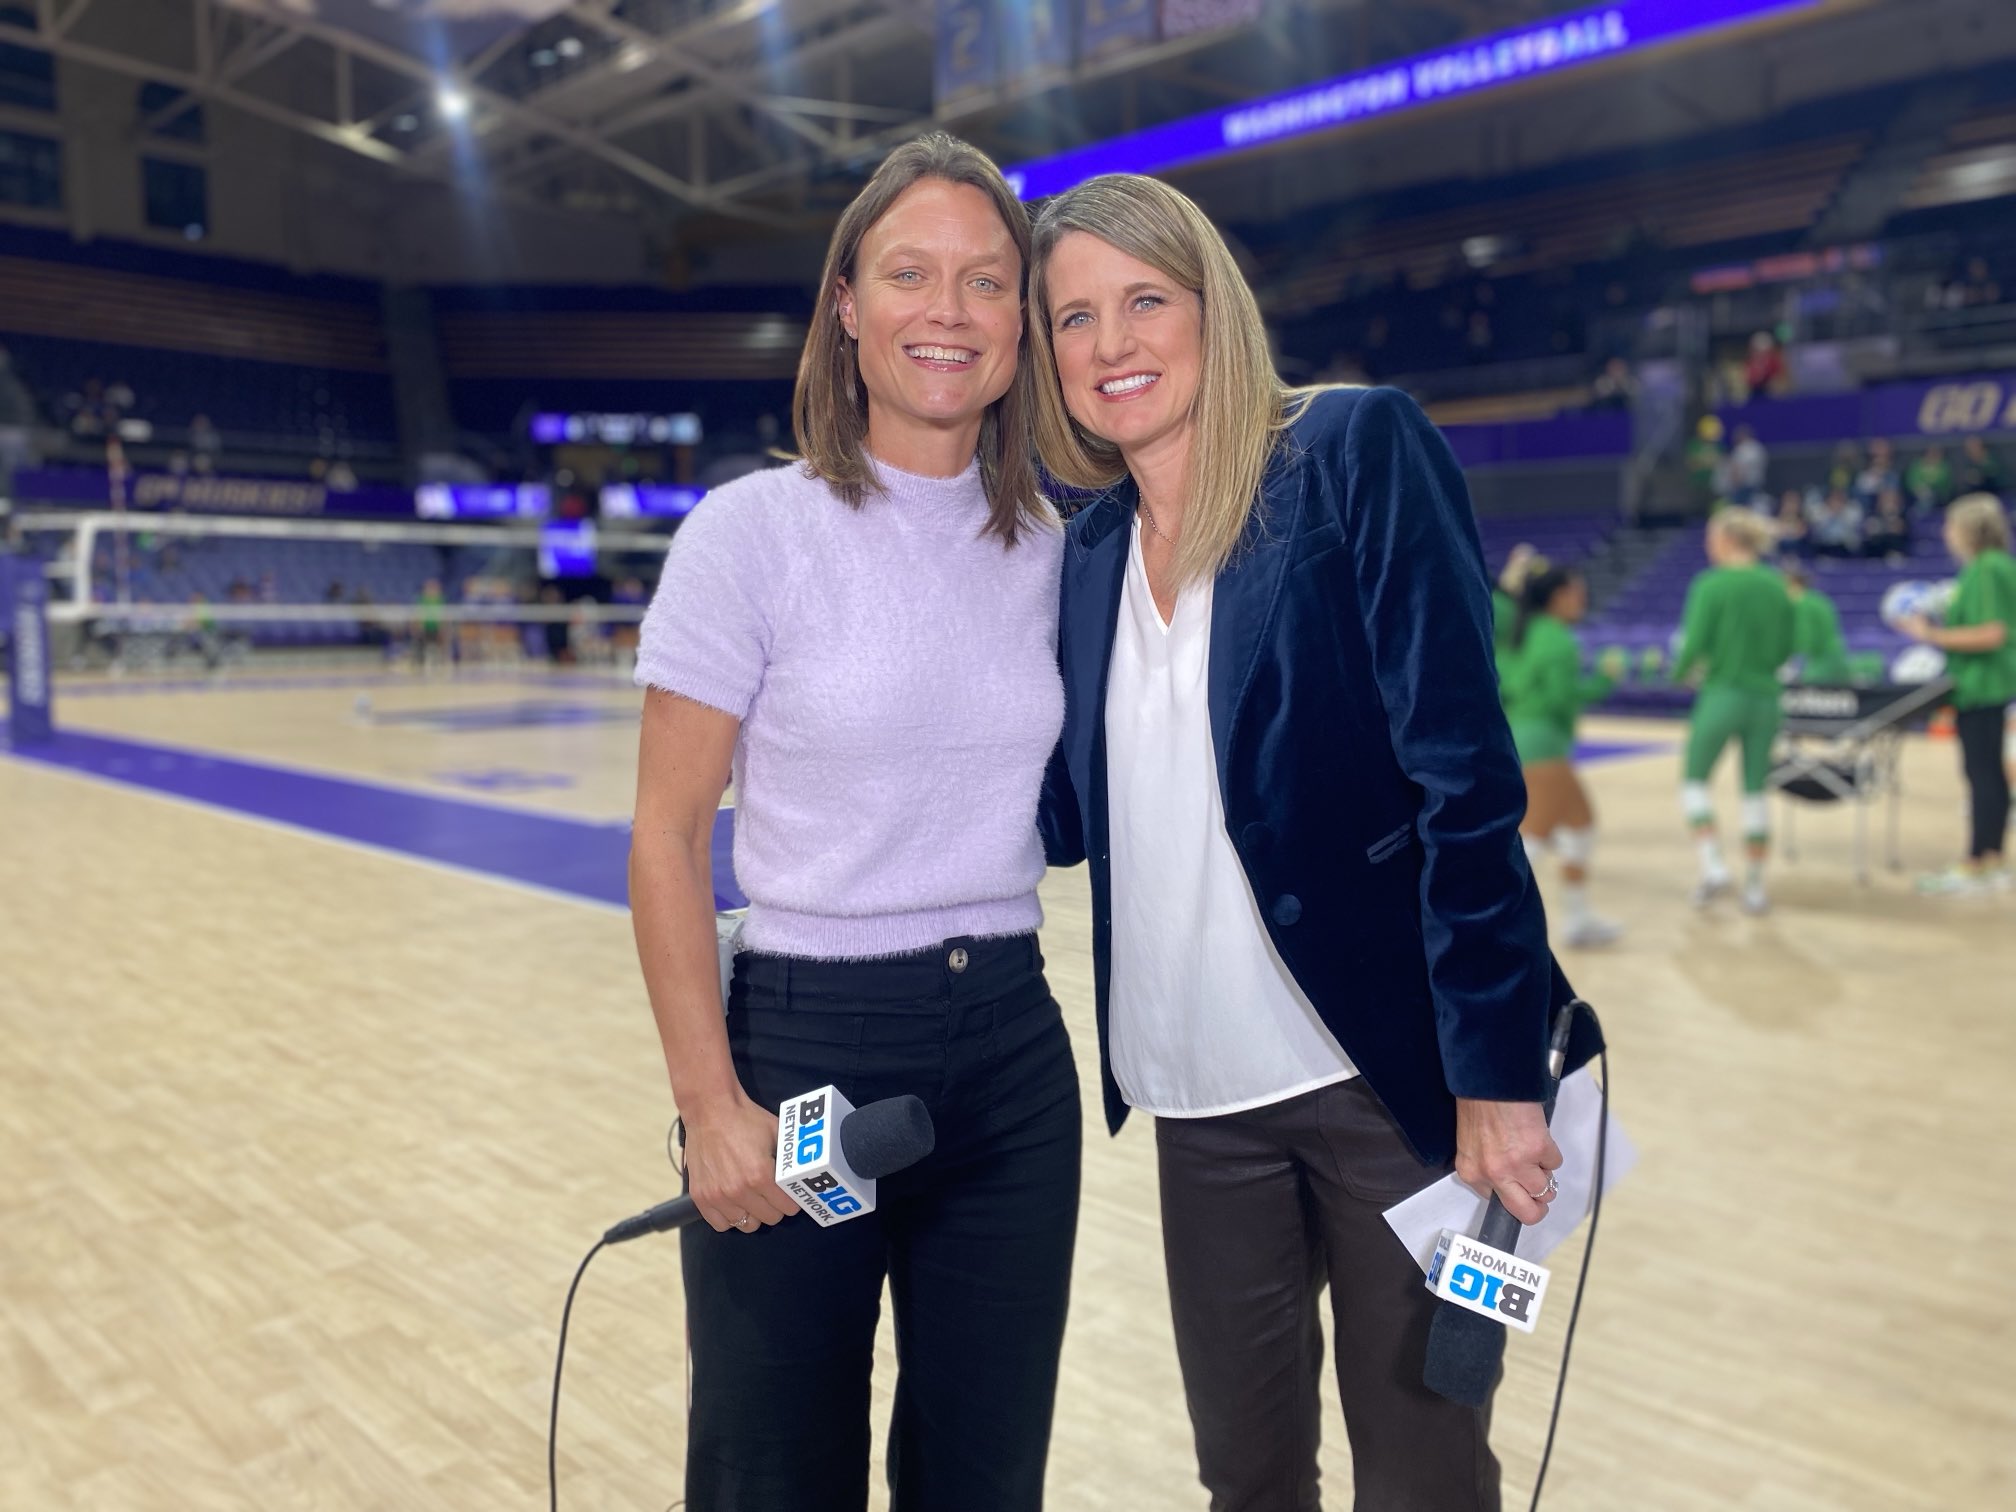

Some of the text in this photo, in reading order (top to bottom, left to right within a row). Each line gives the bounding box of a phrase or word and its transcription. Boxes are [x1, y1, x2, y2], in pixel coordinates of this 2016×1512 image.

[1222, 9, 1629, 147] WASHINGTON VOLLEYBALL
[783, 1104, 796, 1171] NETWORK
[787, 1181, 834, 1222] NETWORK
[1460, 1246, 1541, 1287] NETWORK
